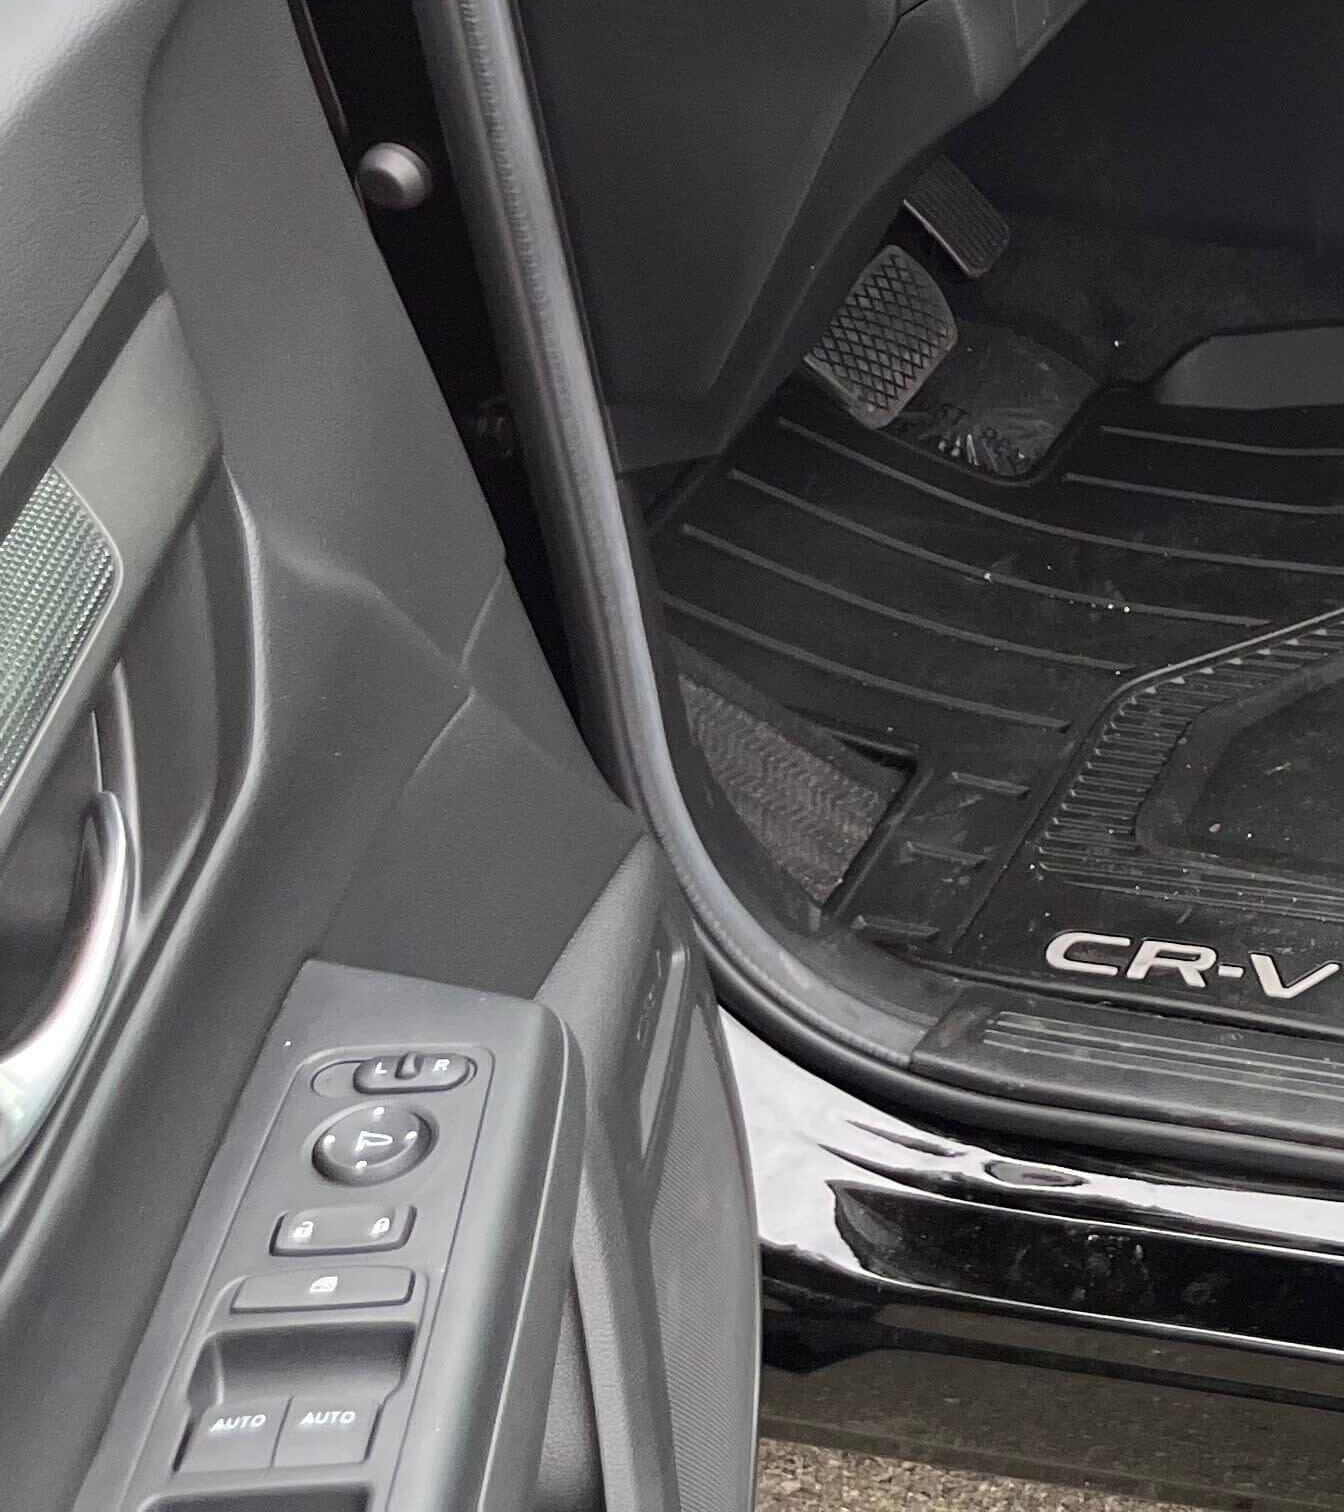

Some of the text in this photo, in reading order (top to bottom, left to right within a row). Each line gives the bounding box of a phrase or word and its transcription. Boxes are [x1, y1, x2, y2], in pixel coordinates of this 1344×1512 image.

[1044, 930, 1342, 1000] CR-V
[375, 1058, 451, 1075] L R
[210, 1414, 267, 1433] AUTO
[300, 1410, 356, 1426] AUTO
